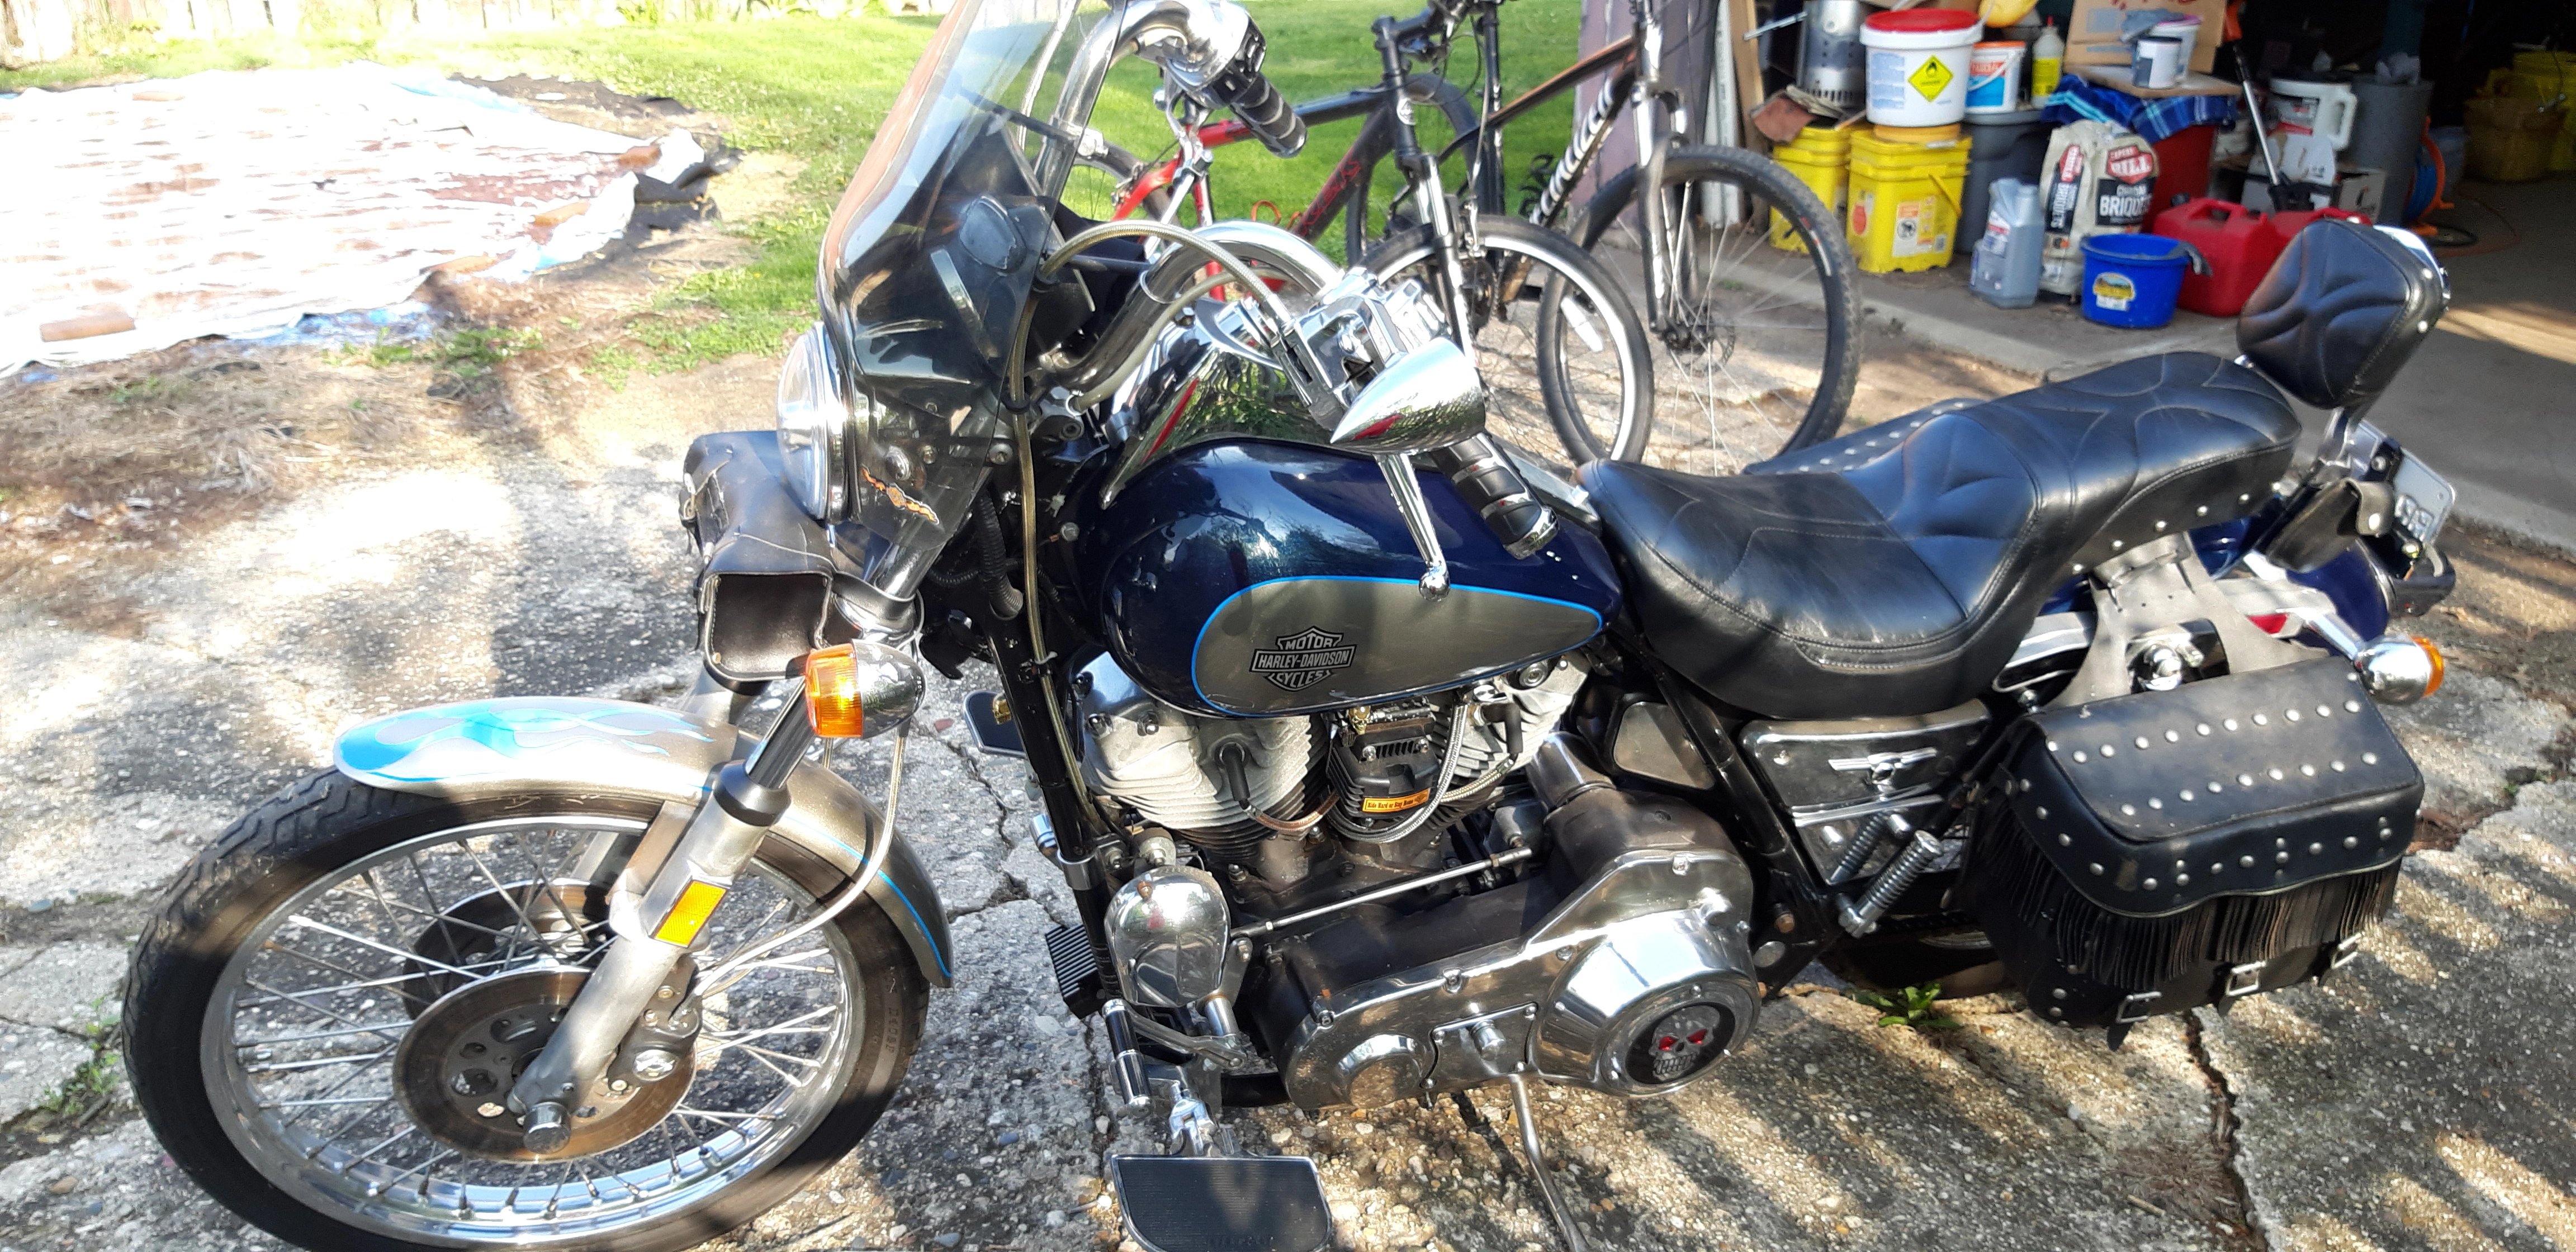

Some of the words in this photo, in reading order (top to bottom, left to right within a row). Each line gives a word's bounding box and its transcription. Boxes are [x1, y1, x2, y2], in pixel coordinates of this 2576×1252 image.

[1285, 632, 1333, 650] MOTOR
[1258, 650, 1349, 668] HARLEY-DAVIDSON
[1276, 670, 1324, 688] CYCLES
